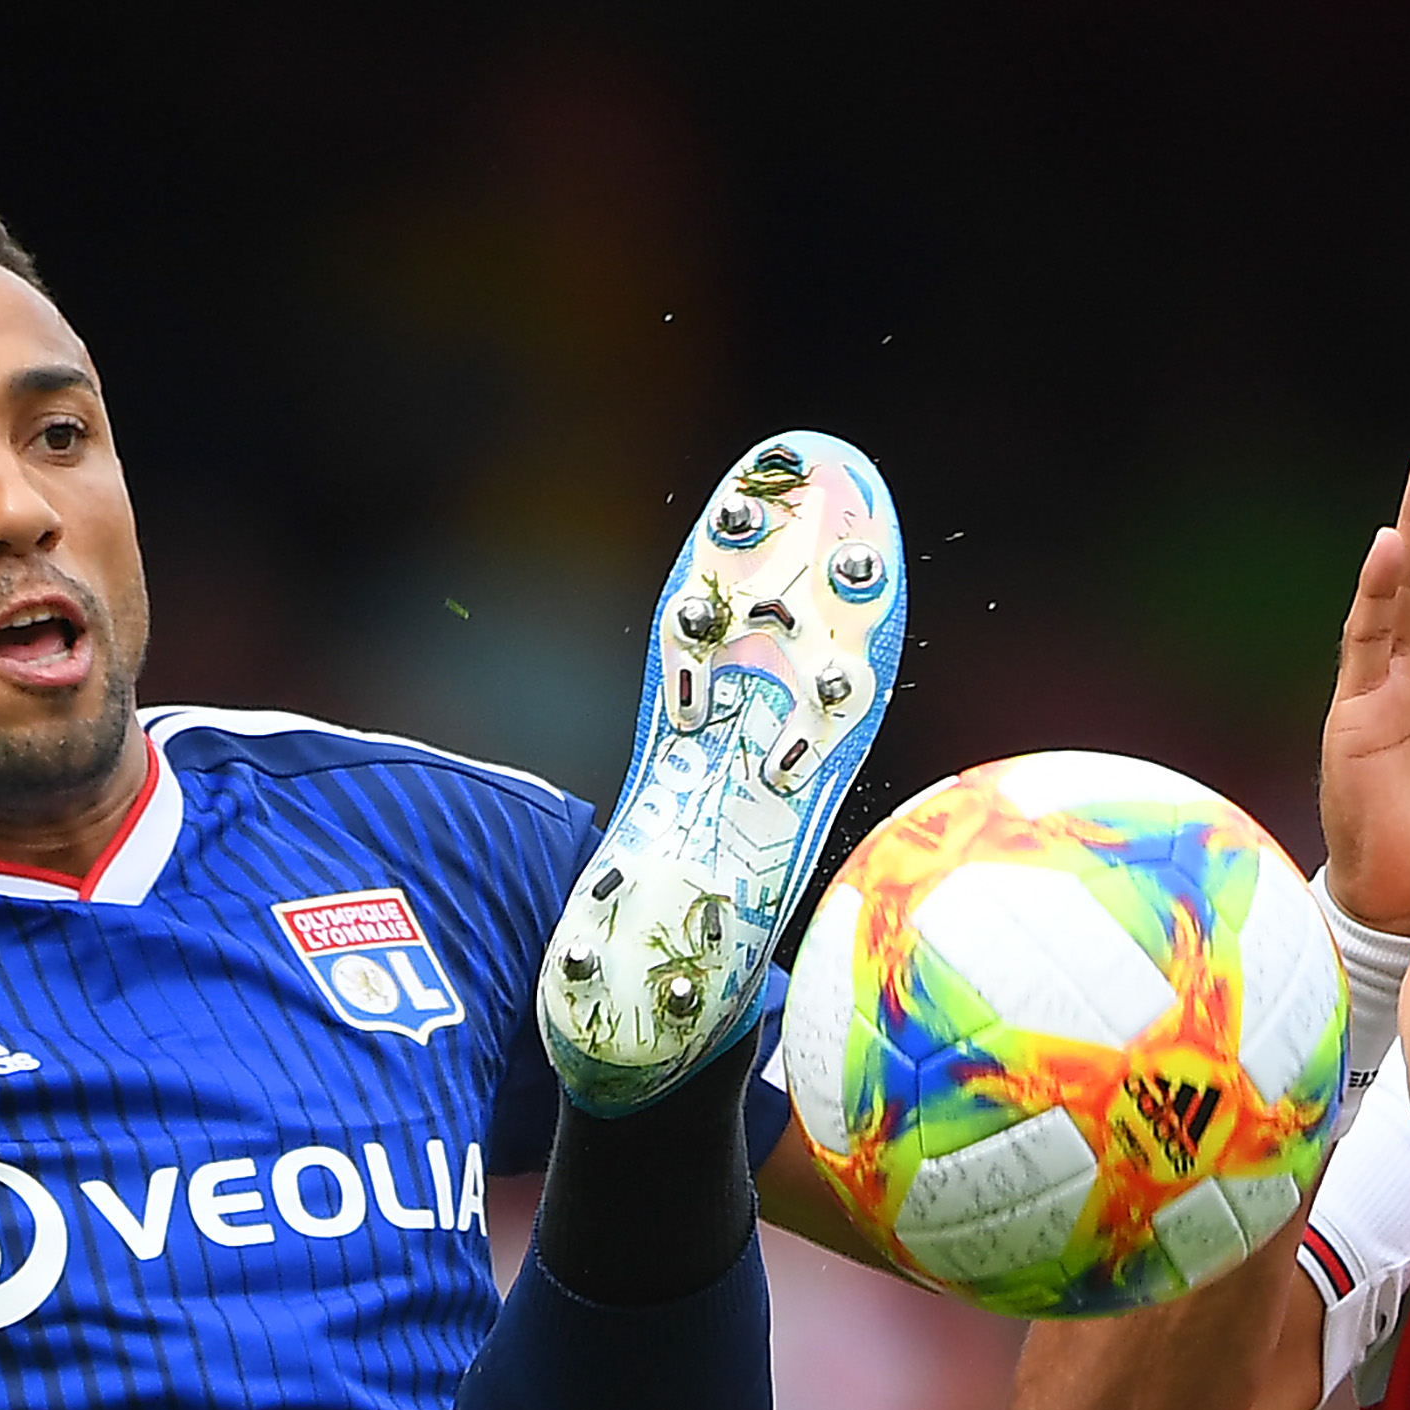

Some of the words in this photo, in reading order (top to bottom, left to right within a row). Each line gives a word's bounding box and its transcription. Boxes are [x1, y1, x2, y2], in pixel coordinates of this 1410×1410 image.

[293, 901, 404, 932] OLYMPIQUE
[303, 920, 412, 949] LYONNAIS
[331, 951, 450, 1015] OL
[80, 1139, 488, 1261] VEOLIA
